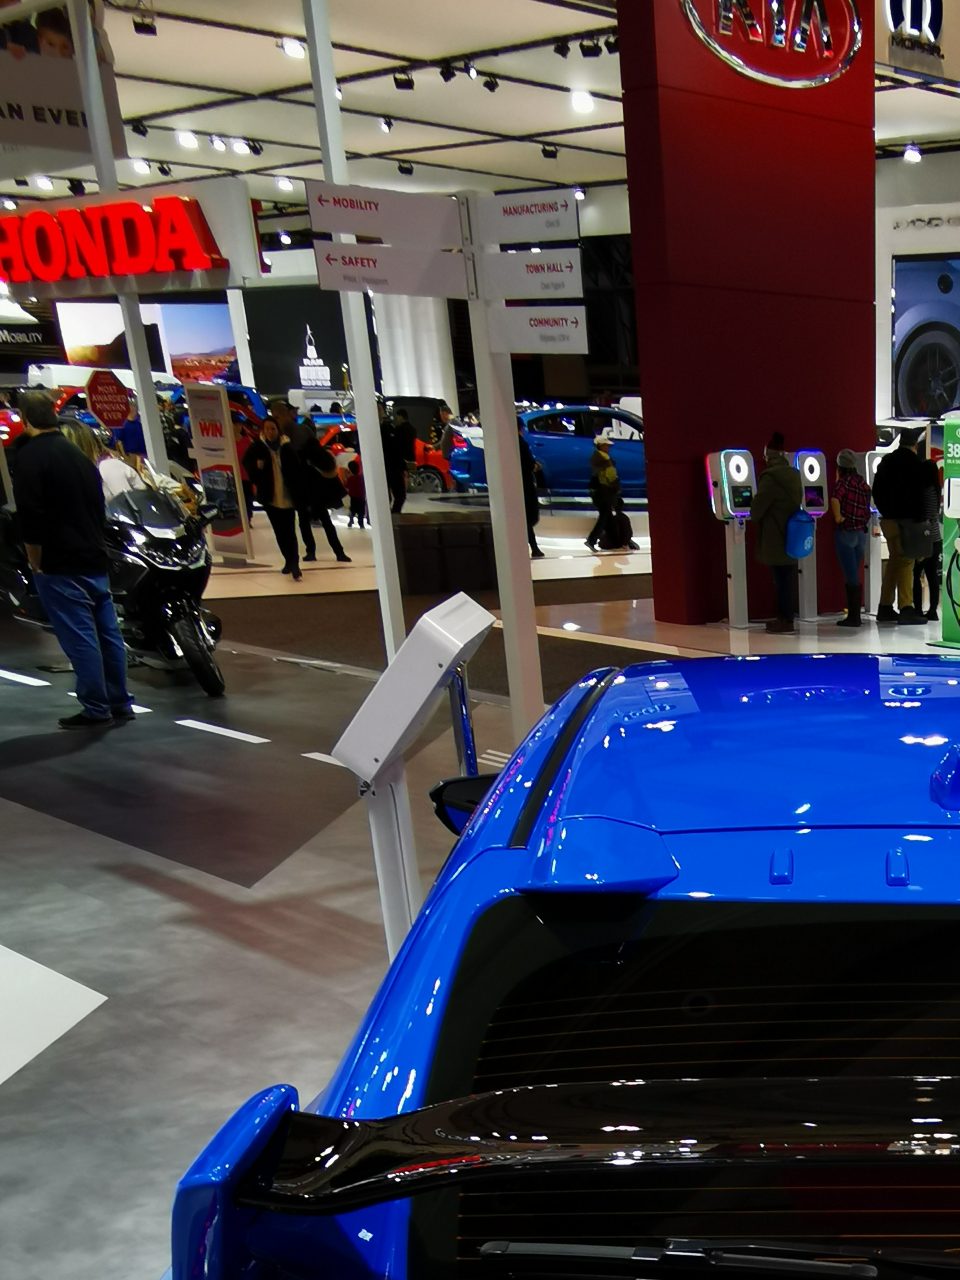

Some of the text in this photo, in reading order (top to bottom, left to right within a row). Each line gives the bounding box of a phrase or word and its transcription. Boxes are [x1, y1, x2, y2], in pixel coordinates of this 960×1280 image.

[333, 197, 379, 211] MOBILITY
[502, 201, 559, 216] MANUFACTURING
[0, 196, 220, 283] HONDA
[342, 255, 378, 268] SAFETY
[525, 262, 564, 274] TOWN HALL
[529, 318, 569, 328] COMMUNITY
